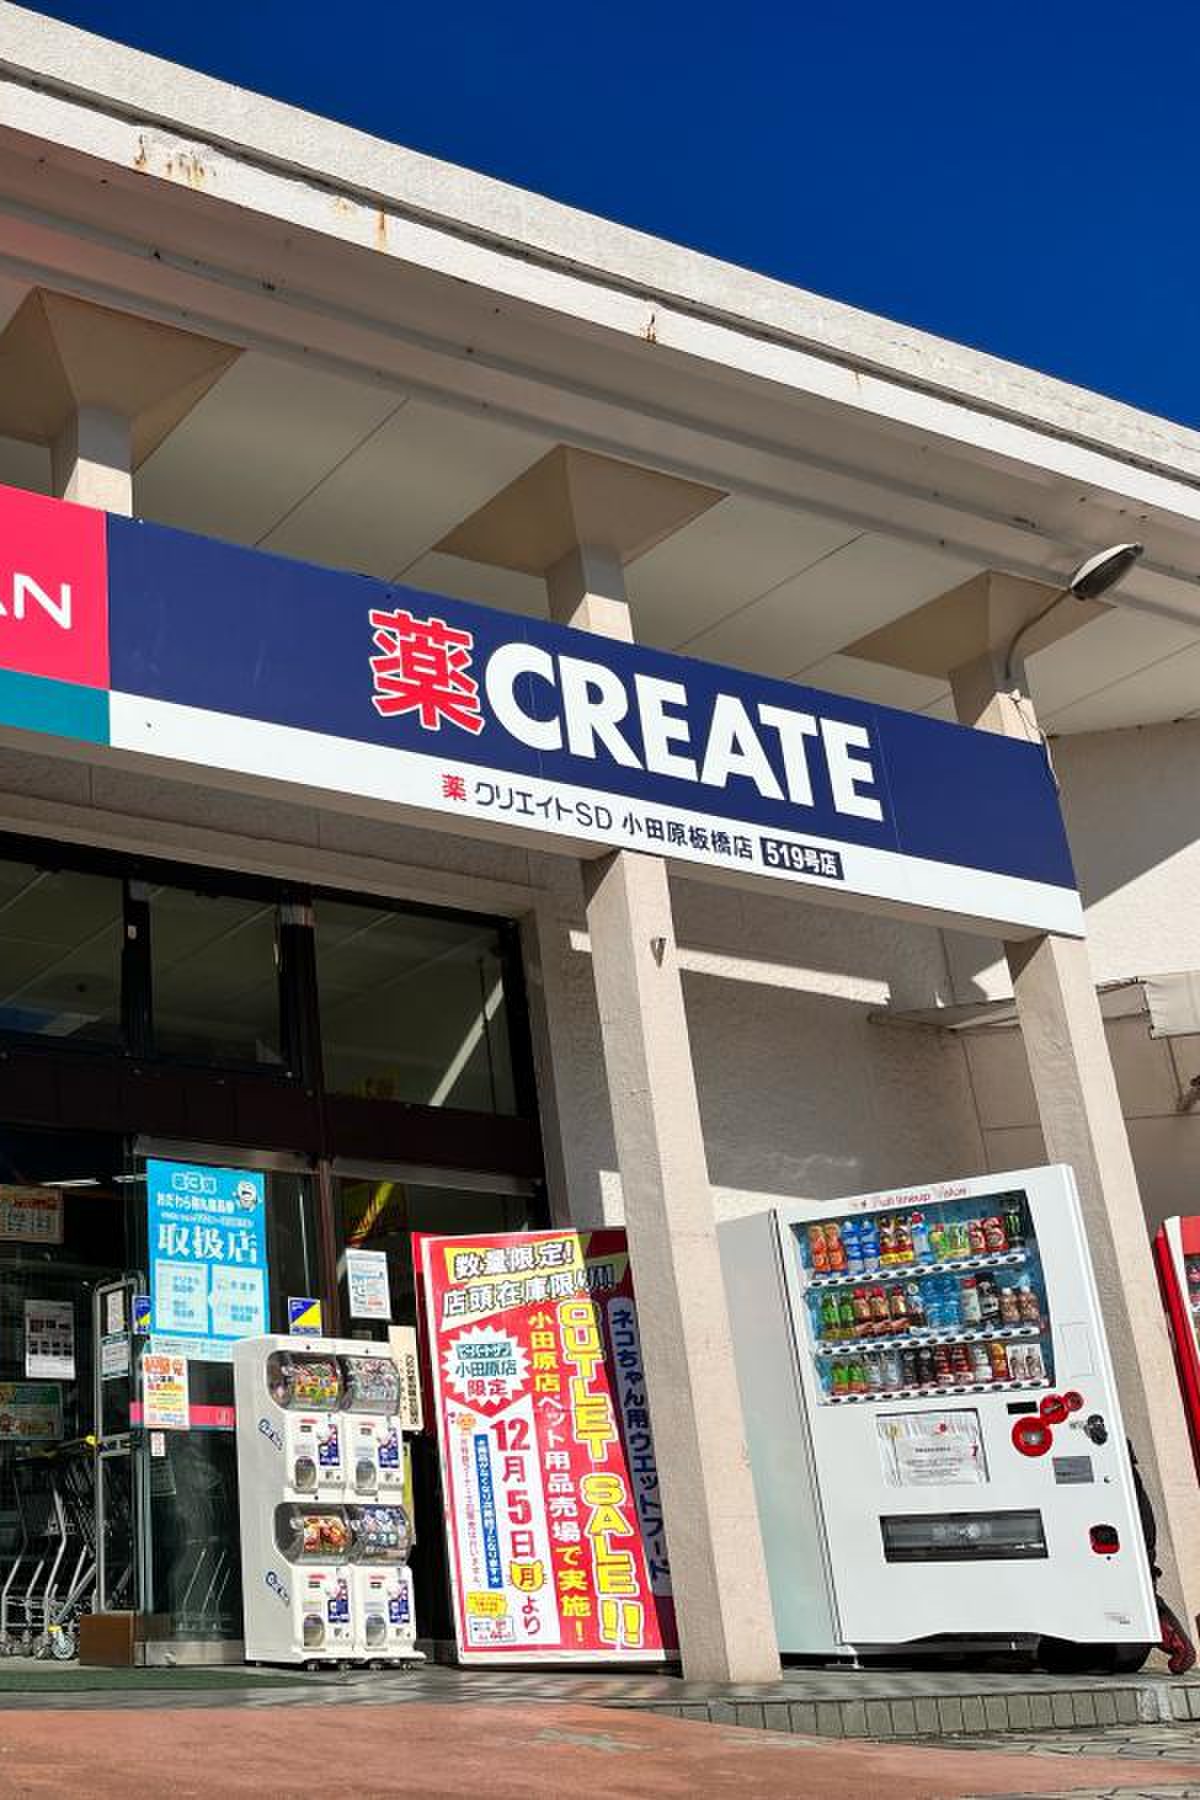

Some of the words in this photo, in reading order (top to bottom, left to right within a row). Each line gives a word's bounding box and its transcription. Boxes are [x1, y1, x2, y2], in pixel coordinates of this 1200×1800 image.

[368, 607, 487, 737] 薬
[484, 642, 884, 823] CREATE
[474, 781, 614, 831] クリエイトSD
[621, 813, 754, 861] 小田原板橋店
[765, 840, 840, 877] 519号店
[158, 1222, 258, 1265] 取扱店
[454, 1239, 575, 1280] 数量限定!
[557, 1301, 619, 1462] OUTLET
